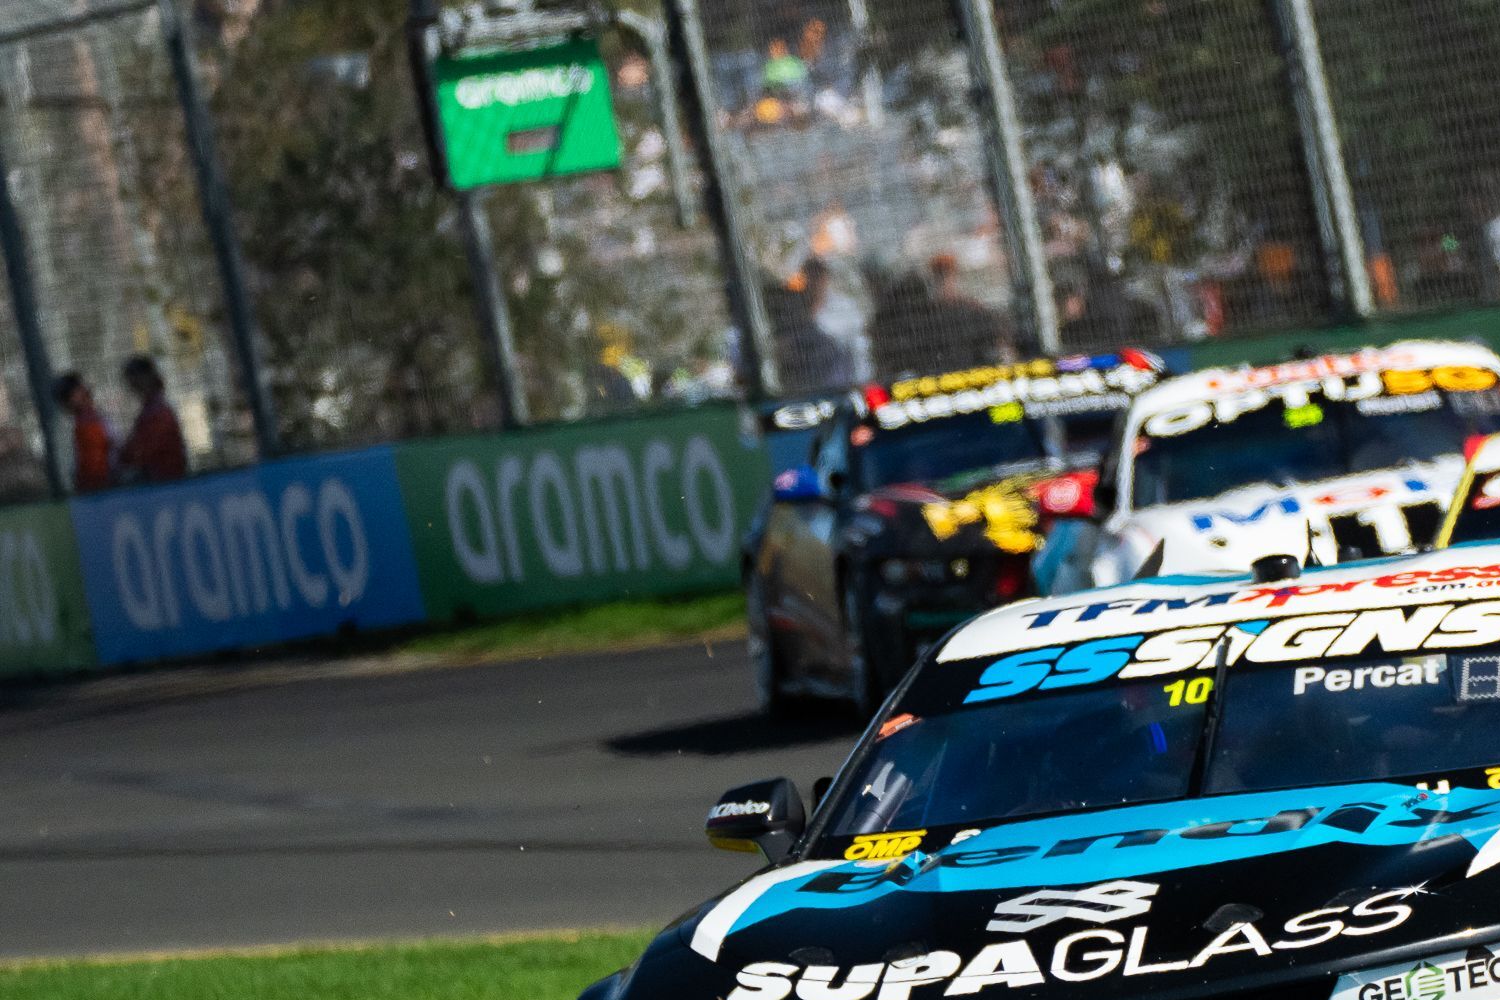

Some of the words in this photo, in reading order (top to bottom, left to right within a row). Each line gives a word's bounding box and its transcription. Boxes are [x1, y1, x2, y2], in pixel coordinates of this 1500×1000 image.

[446, 436, 735, 584] aramco
[112, 483, 371, 630] aramco
[1163, 677, 1214, 707] 10
[1293, 659, 1440, 696] Percat
[844, 834, 924, 861] OMP
